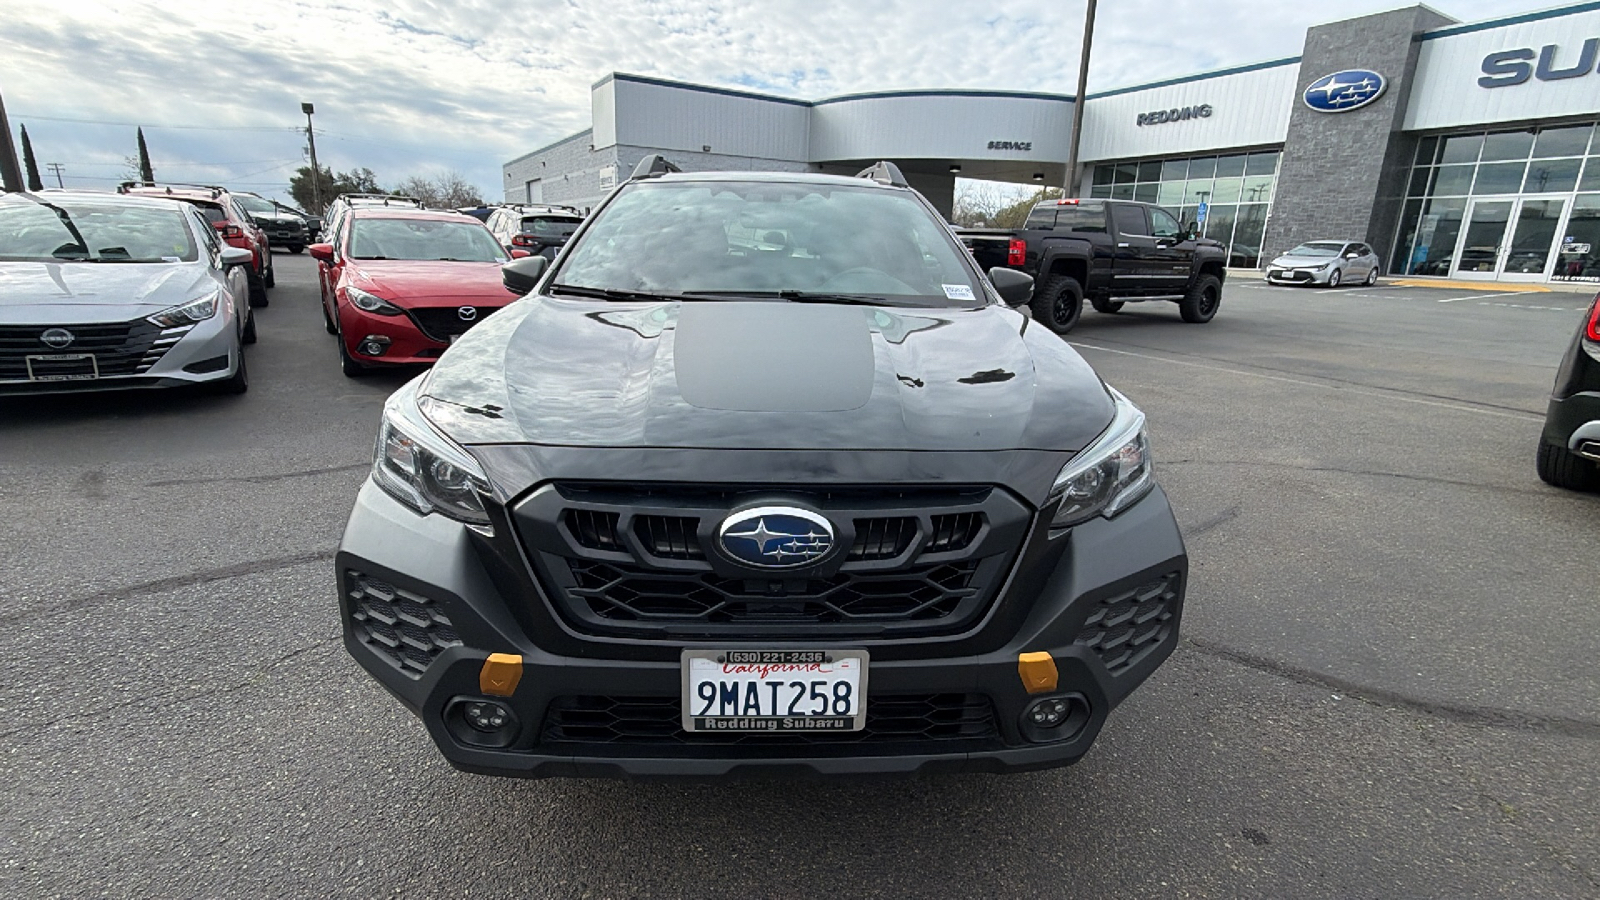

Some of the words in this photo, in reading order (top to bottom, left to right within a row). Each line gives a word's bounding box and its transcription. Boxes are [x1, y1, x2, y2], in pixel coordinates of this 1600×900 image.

[1478, 38, 1600, 88] SU
[1136, 104, 1213, 127] REDDING
[987, 141, 1033, 151] SERVICE
[729, 652, 761, 663] (530)
[763, 652, 823, 663] 221-2436
[723, 663, 834, 679] California
[697, 680, 852, 716] 9MAT258
[704, 718, 778, 730] Redding
[782, 718, 844, 729] Subaru
